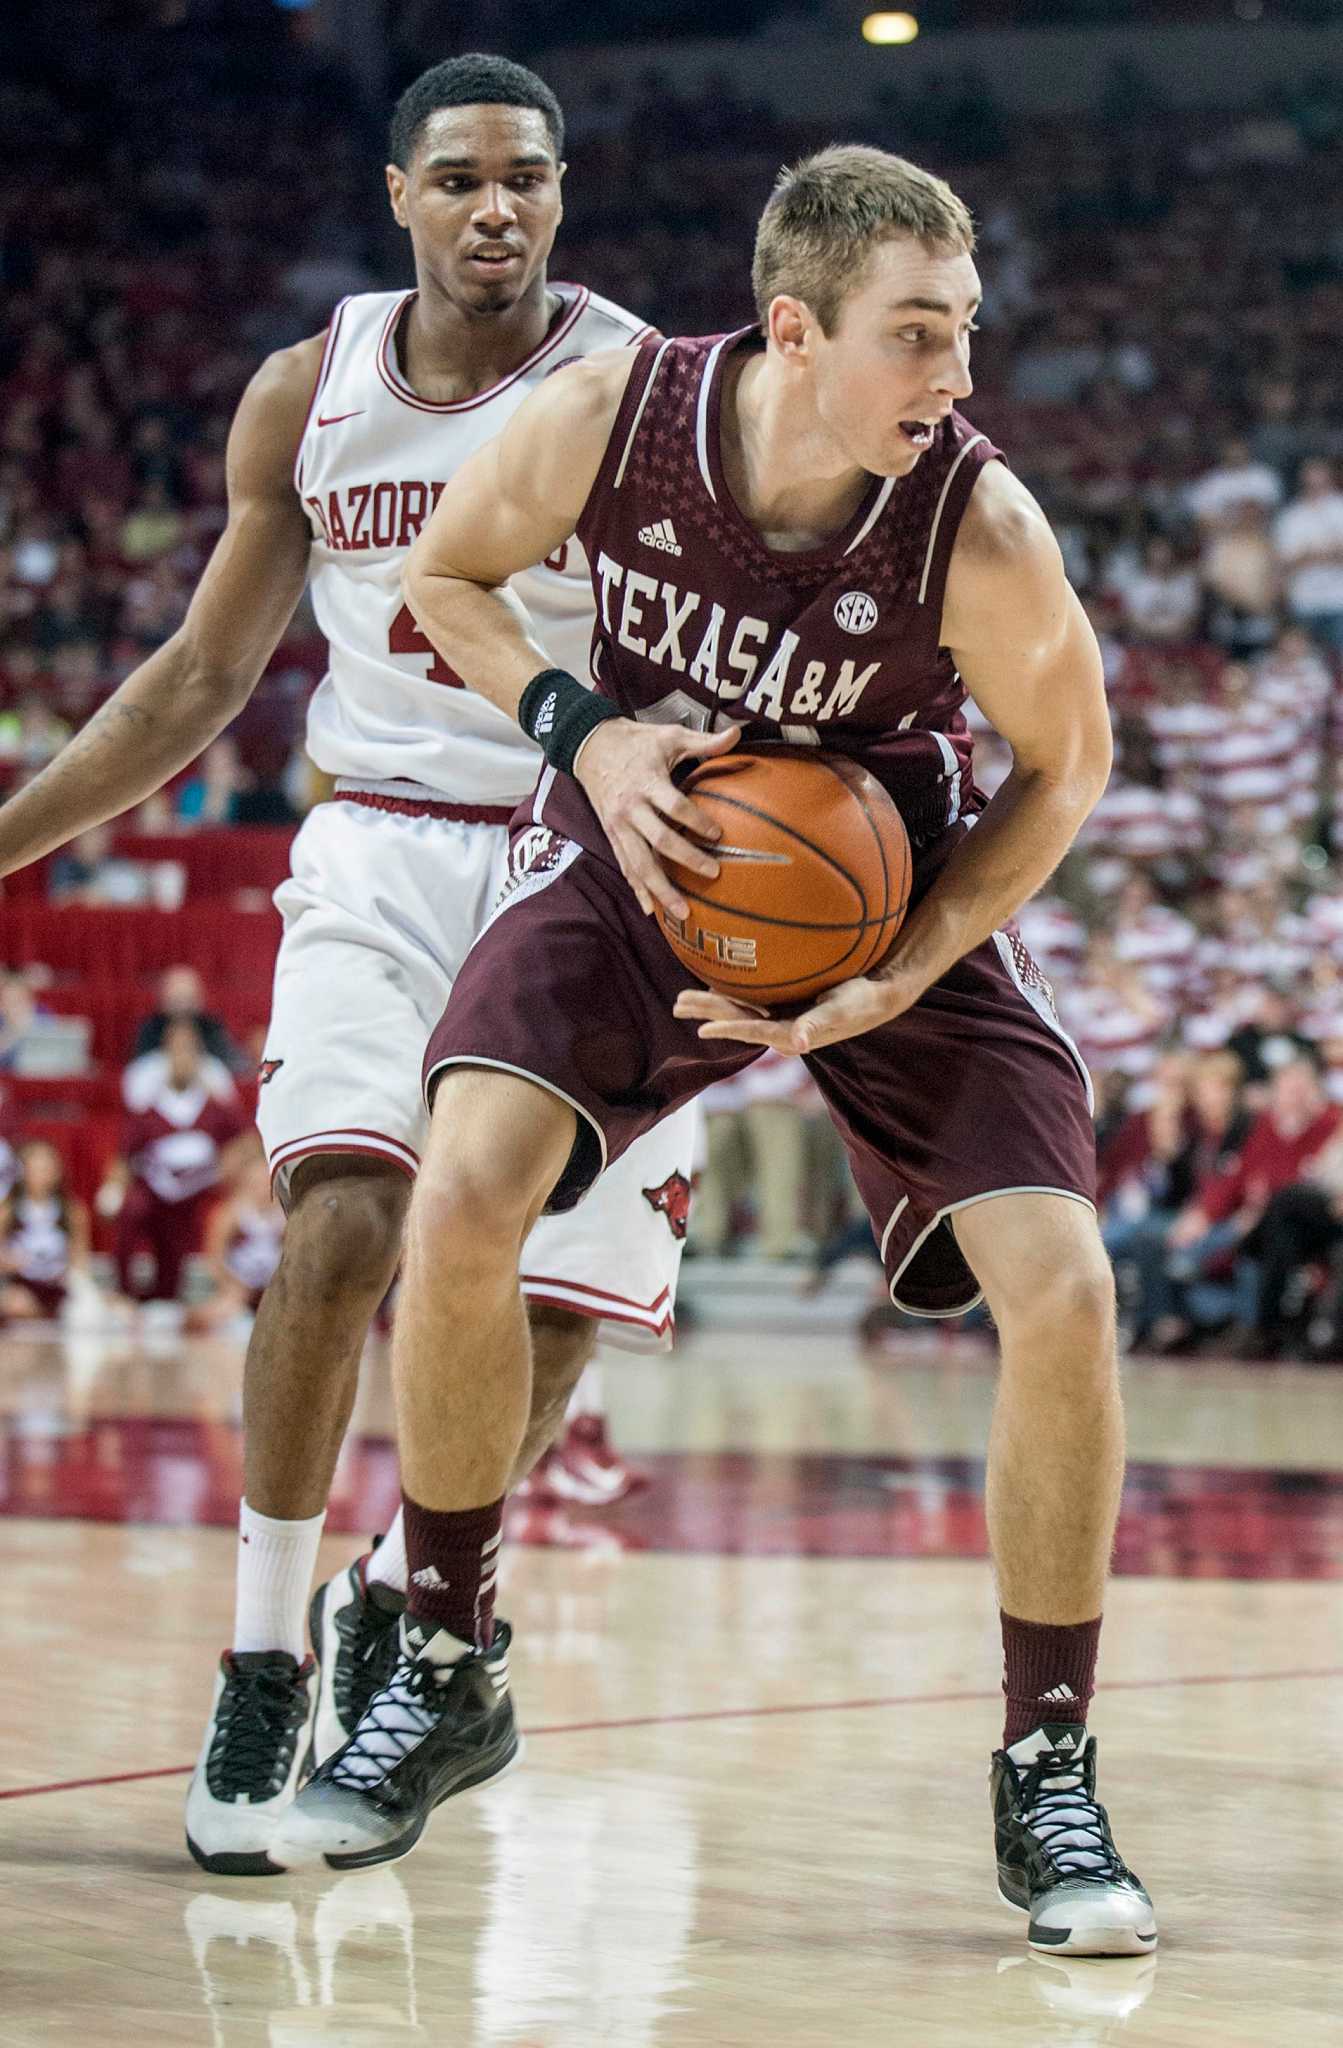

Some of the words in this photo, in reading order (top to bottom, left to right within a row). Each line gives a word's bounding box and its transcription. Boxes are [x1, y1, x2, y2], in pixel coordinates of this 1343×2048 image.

[638, 530, 683, 557] adidas
[836, 593, 876, 633] SEC
[597, 551, 769, 699] TEXAS
[744, 629, 882, 722] A&M
